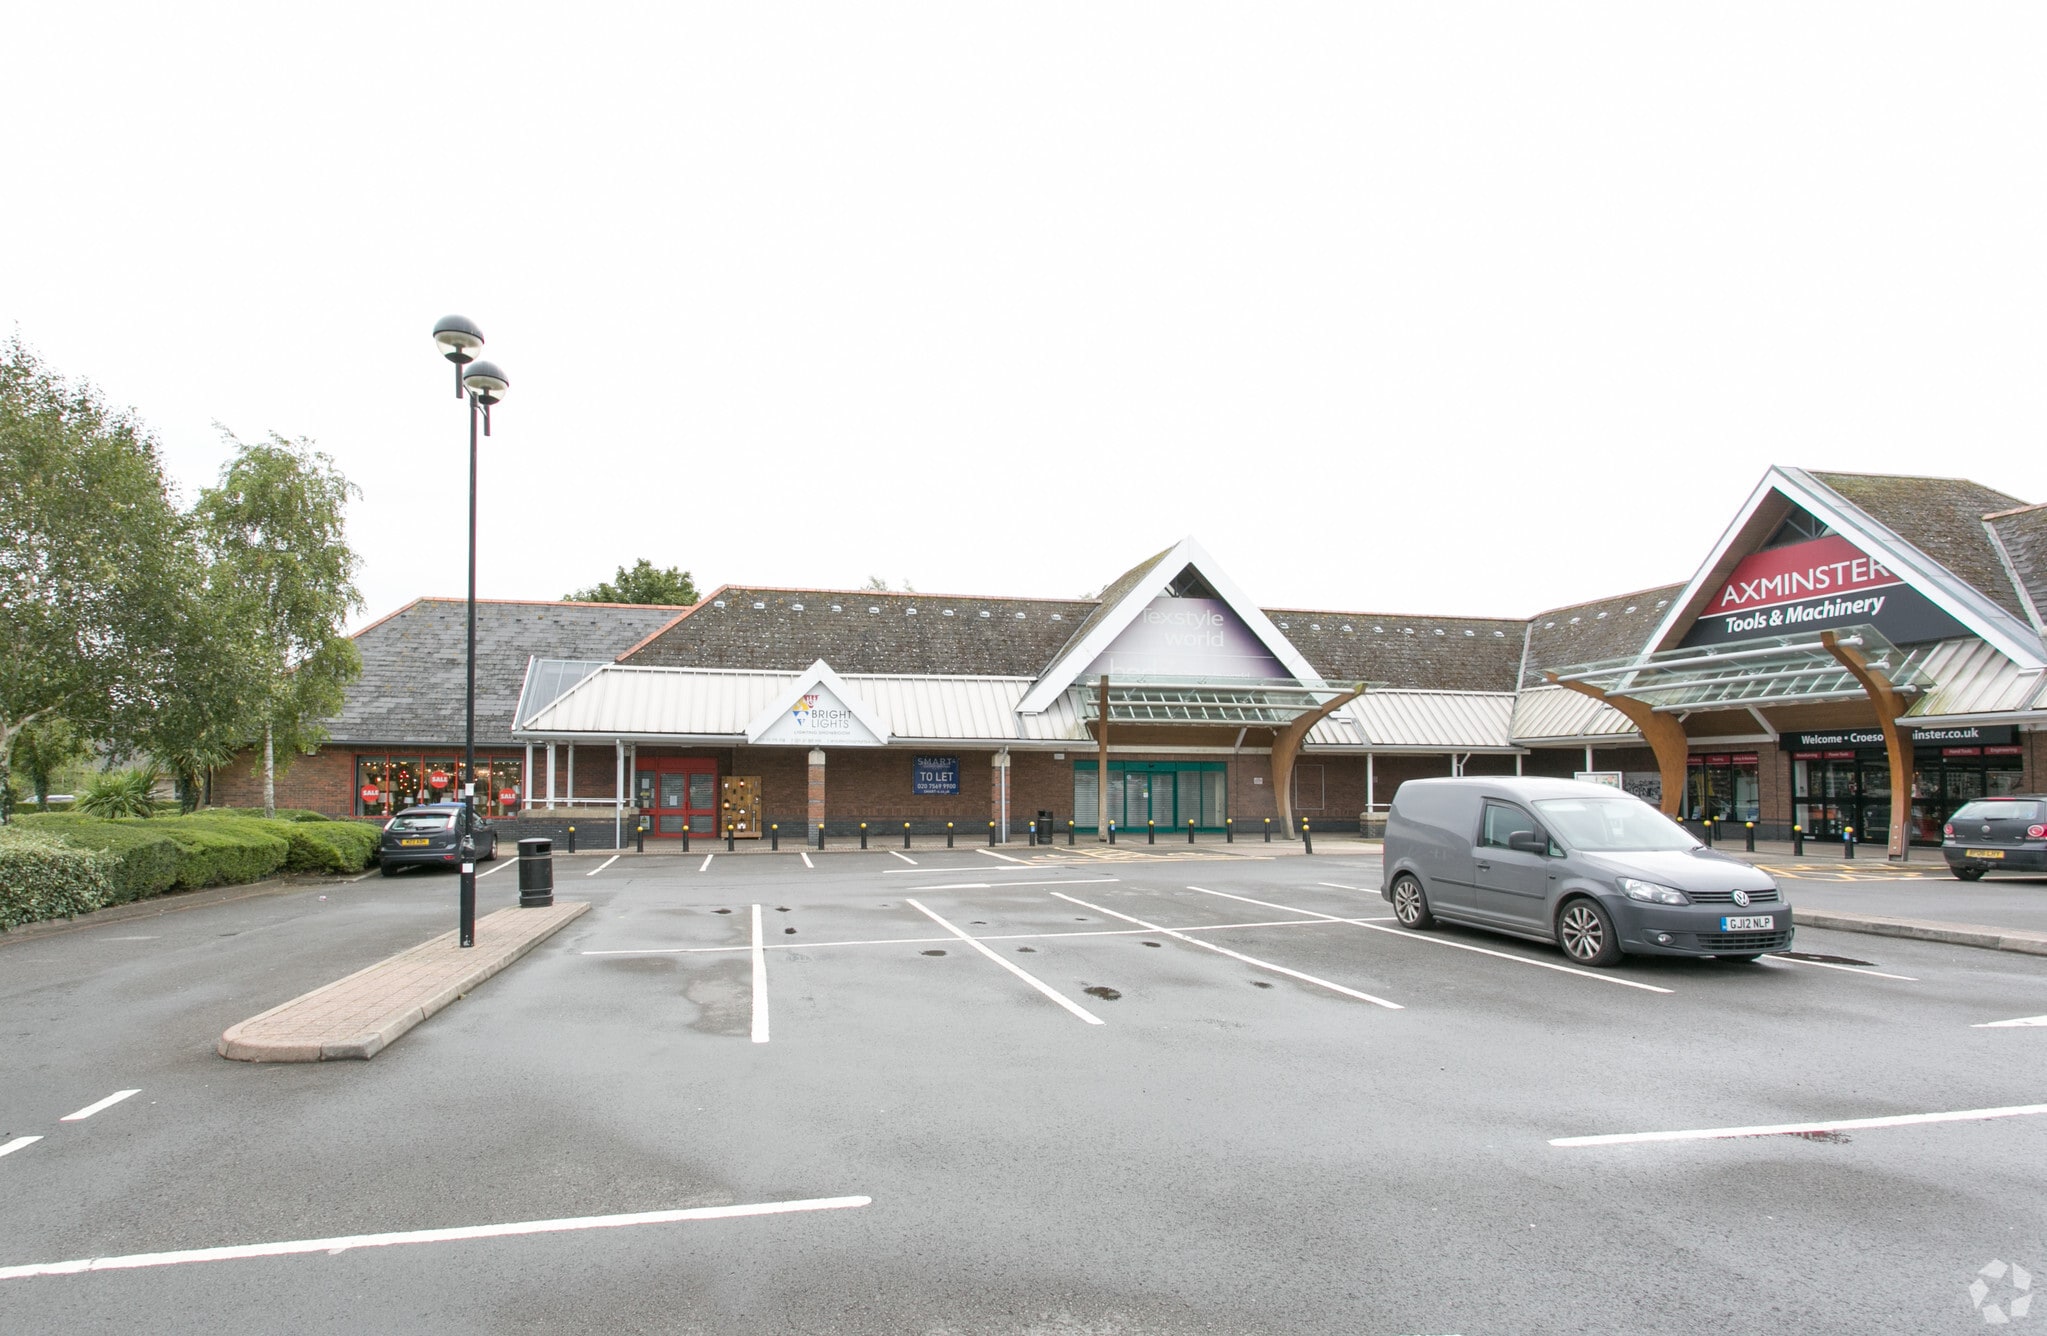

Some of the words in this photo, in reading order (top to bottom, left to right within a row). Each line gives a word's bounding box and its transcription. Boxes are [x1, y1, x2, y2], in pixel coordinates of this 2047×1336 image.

[1720, 556, 1890, 607] AXMINSTER
[1143, 608, 1224, 628] Texstyle
[1725, 611, 1767, 634] Tools
[1768, 609, 1784, 626] &
[1785, 595, 1886, 625] Machinery
[1165, 630, 1224, 647] world
[811, 709, 852, 719] BRIGHT
[811, 719, 849, 729] LIGHTS
[1801, 734, 1843, 745] Welcome
[1850, 732, 1884, 743] Croeso
[1912, 727, 1980, 740] inster.co.uk
[920, 771, 933, 782] TO
[935, 771, 954, 782] LET
[1730, 918, 1751, 929] GJ12
[1753, 917, 1770, 928] NLP
